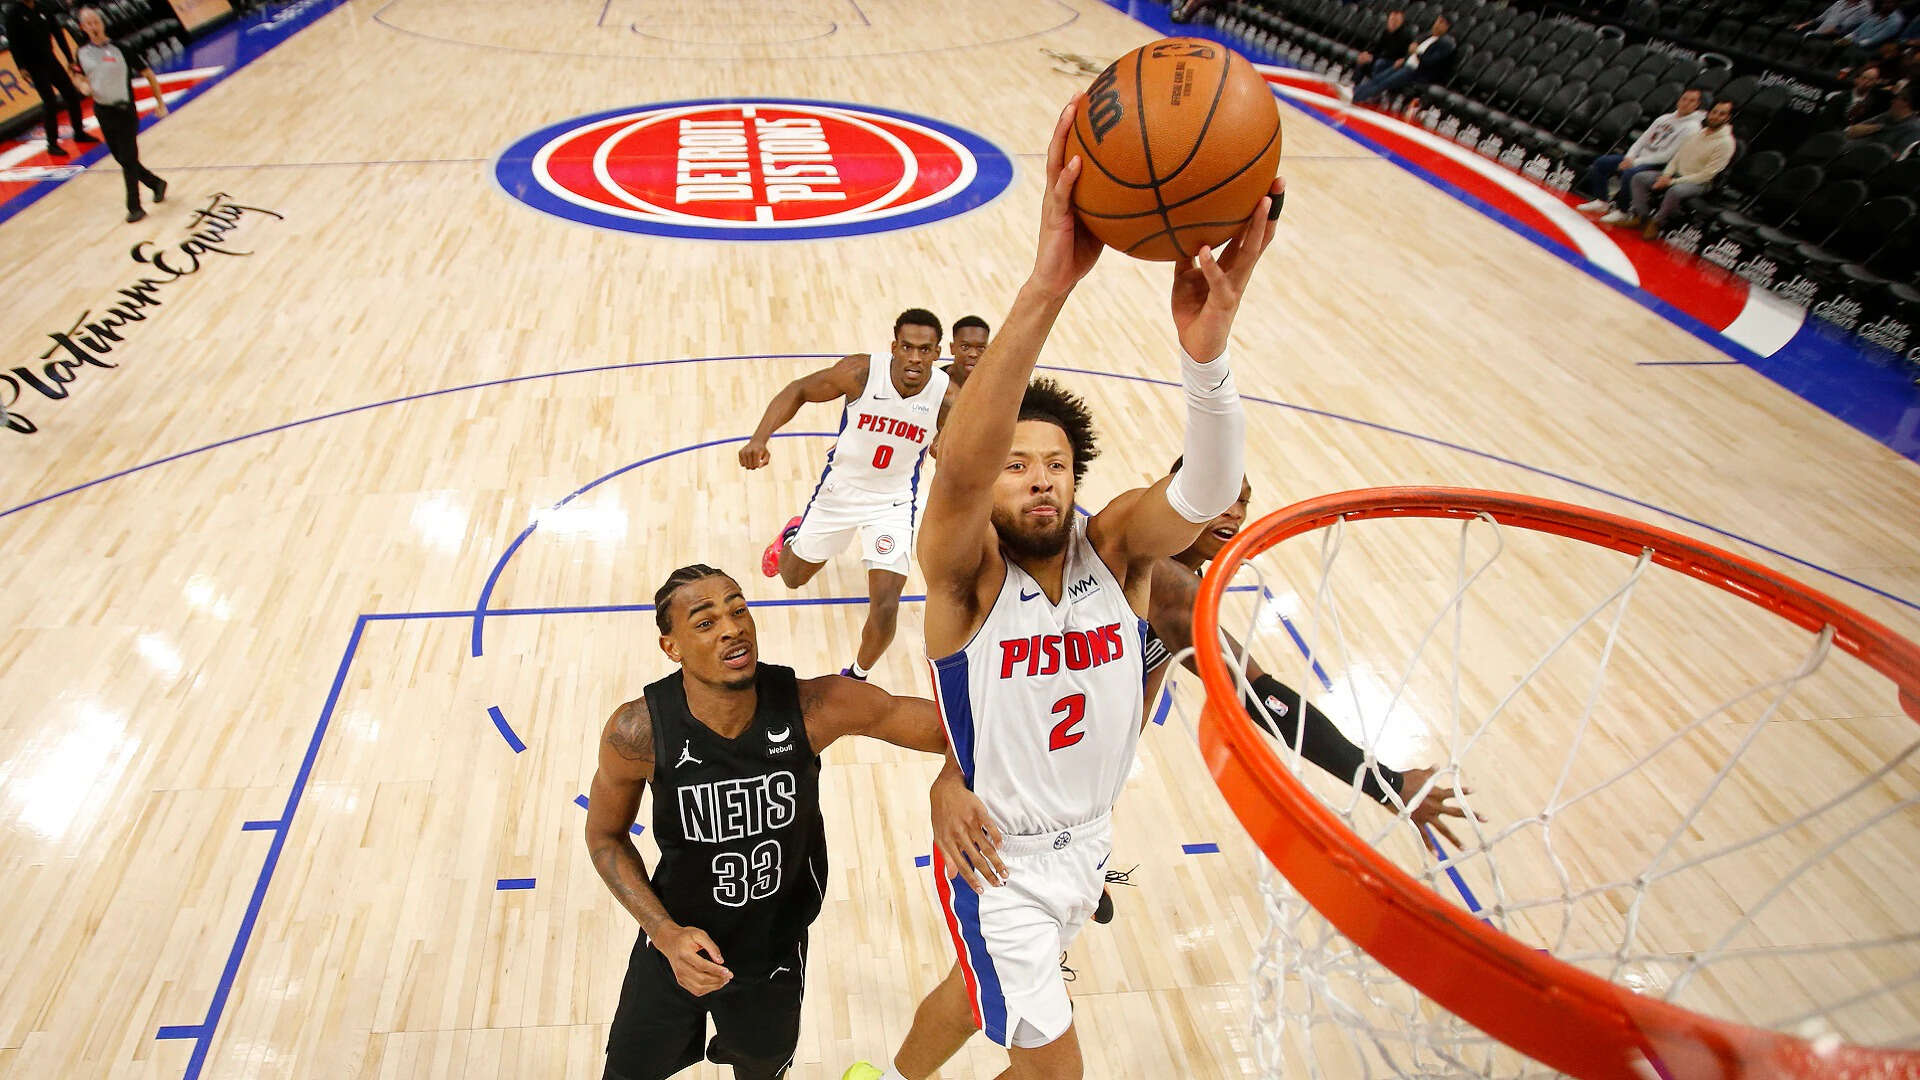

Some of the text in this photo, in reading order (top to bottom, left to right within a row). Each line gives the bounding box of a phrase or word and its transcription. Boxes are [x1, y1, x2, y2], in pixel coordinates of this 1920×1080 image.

[675, 119, 755, 204] DETROIT
[754, 117, 848, 204] PISTONS
[857, 412, 928, 444] PISTONS
[872, 444, 894, 470] 0
[1068, 574, 1099, 599] WM
[999, 622, 1124, 679] PISONS
[1048, 693, 1085, 752] 2
[677, 770, 796, 844] NETS
[711, 839, 782, 908] 33
